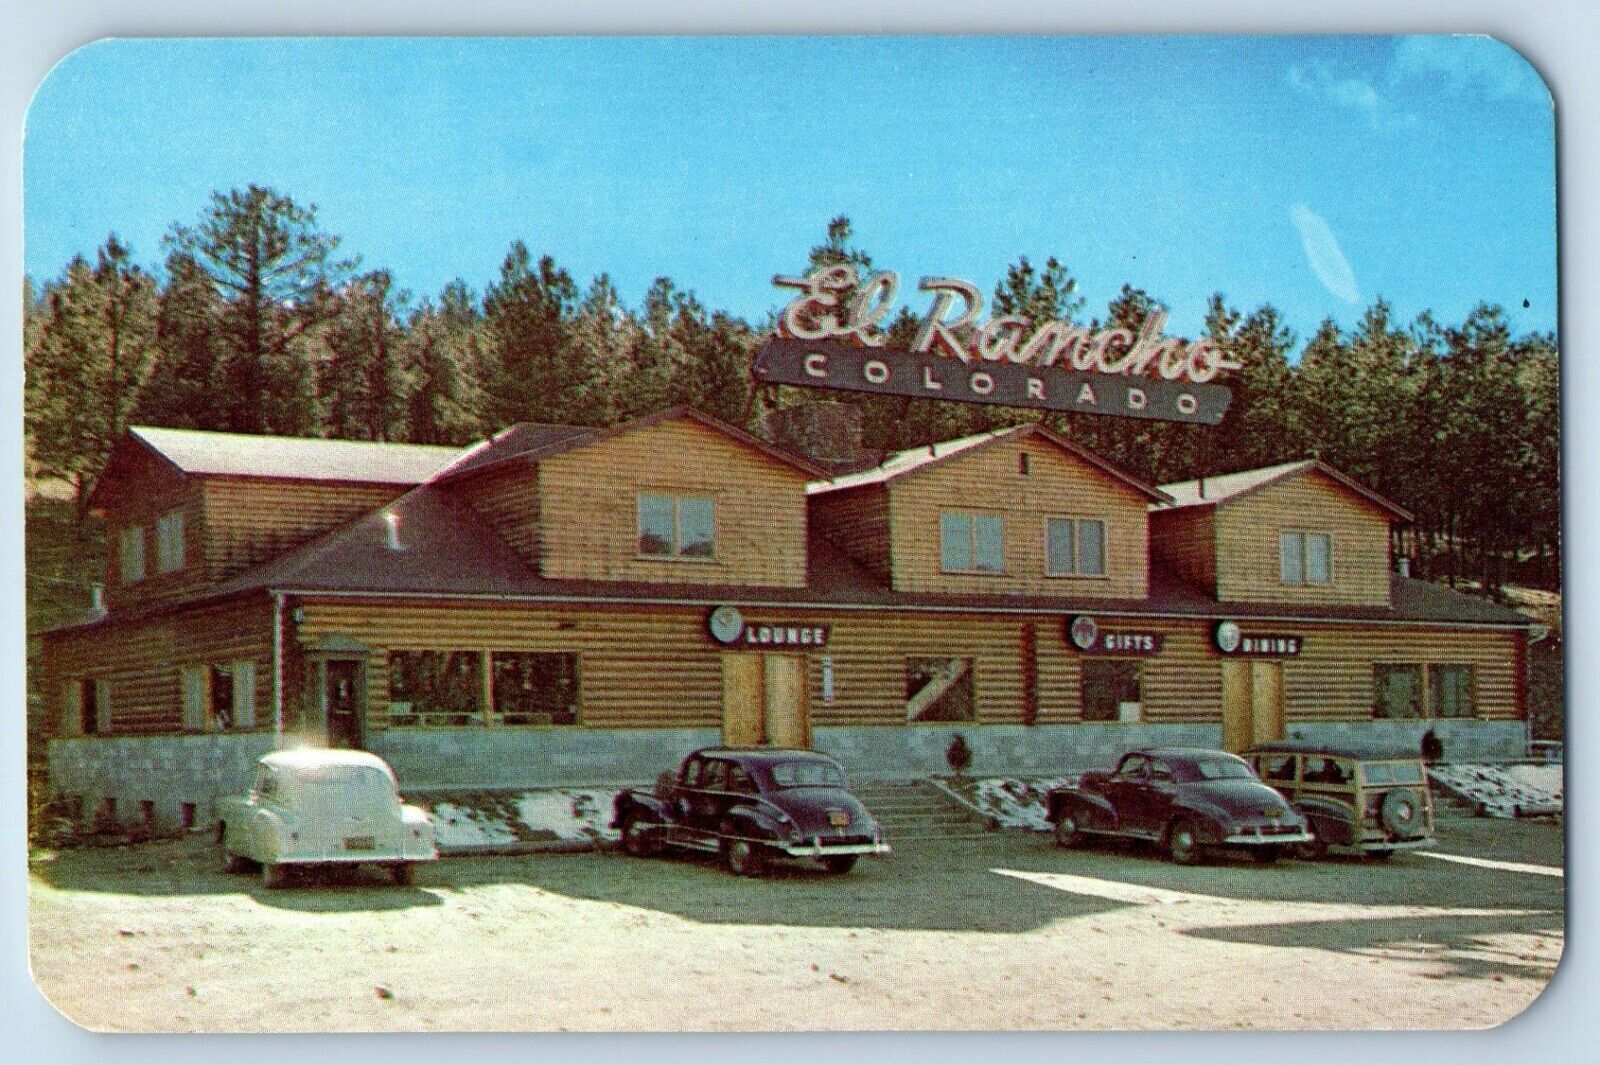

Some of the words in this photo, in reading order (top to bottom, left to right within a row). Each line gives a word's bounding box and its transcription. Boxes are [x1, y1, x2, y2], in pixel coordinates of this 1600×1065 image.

[772, 263, 900, 347] El
[911, 276, 1244, 383] Rancho
[804, 353, 1198, 415] COLORADO
[745, 626, 825, 644] LOUNGE
[1103, 633, 1155, 651] GIFTS
[1242, 637, 1297, 653] DINING
